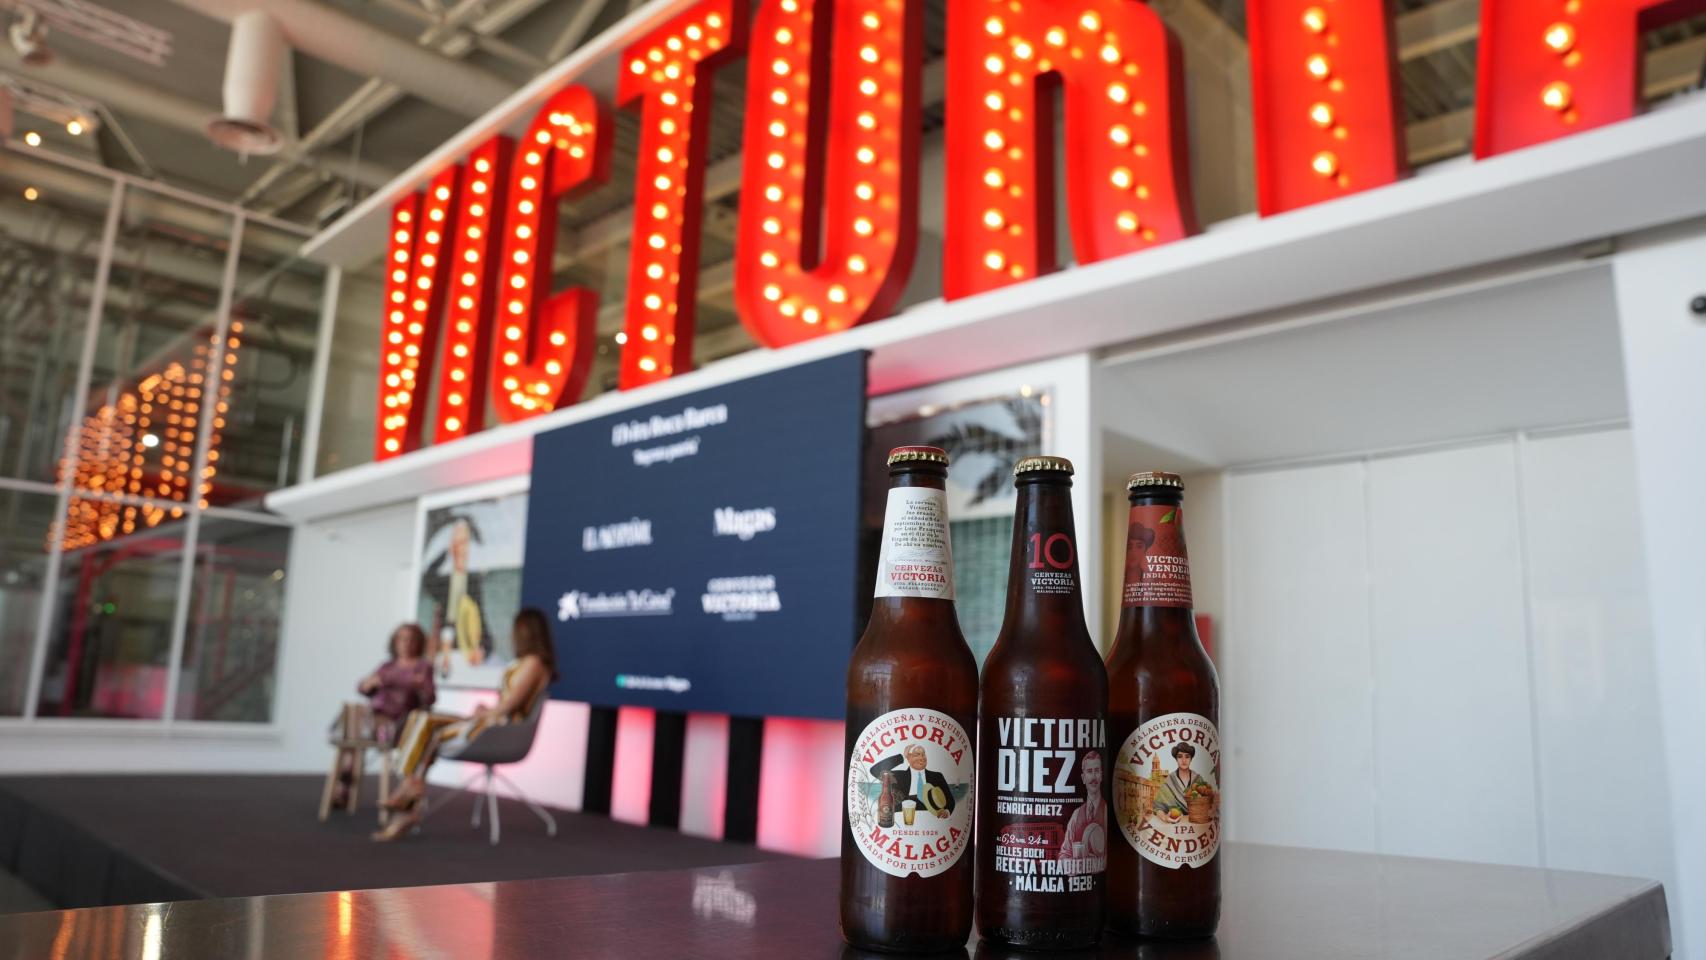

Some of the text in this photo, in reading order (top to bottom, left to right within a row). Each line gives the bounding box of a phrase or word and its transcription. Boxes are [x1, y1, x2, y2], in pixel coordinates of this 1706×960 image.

[374, 0, 1706, 461] VICTOR
[1028, 532, 1074, 569] 10
[1146, 556, 1188, 565] VICTOR
[890, 572, 946, 583] VICTORIA
[894, 564, 943, 573] CERVEZAS
[1147, 565, 1189, 574] VENDEJ
[701, 592, 781, 613] VICTORIA
[861, 714, 914, 750] MALAGUEÑA
[928, 716, 968, 751] EXQUISITA
[863, 724, 963, 766] VICTORIA
[998, 718, 1106, 748] VICTORIA
[1130, 718, 1186, 748] MALAGUEÑA
[1188, 719, 1211, 733] DESDE
[1130, 727, 1219, 766] VICTORIA
[998, 748, 1076, 793] DIEZ
[997, 801, 1062, 816] HENRICH DIETZ
[869, 826, 961, 860] MÁLAGA
[1127, 825, 1211, 862] EXQUISITA CERVEZA
[1175, 826, 1195, 834] IPA
[857, 827, 883, 861] CREADA
[886, 858, 906, 869] POR
[911, 862, 936, 870] LUIS
[996, 845, 1021, 857] HELLES
[996, 856, 1037, 874] RECETA
[1016, 874, 1092, 892] MÁLAGA 1928
